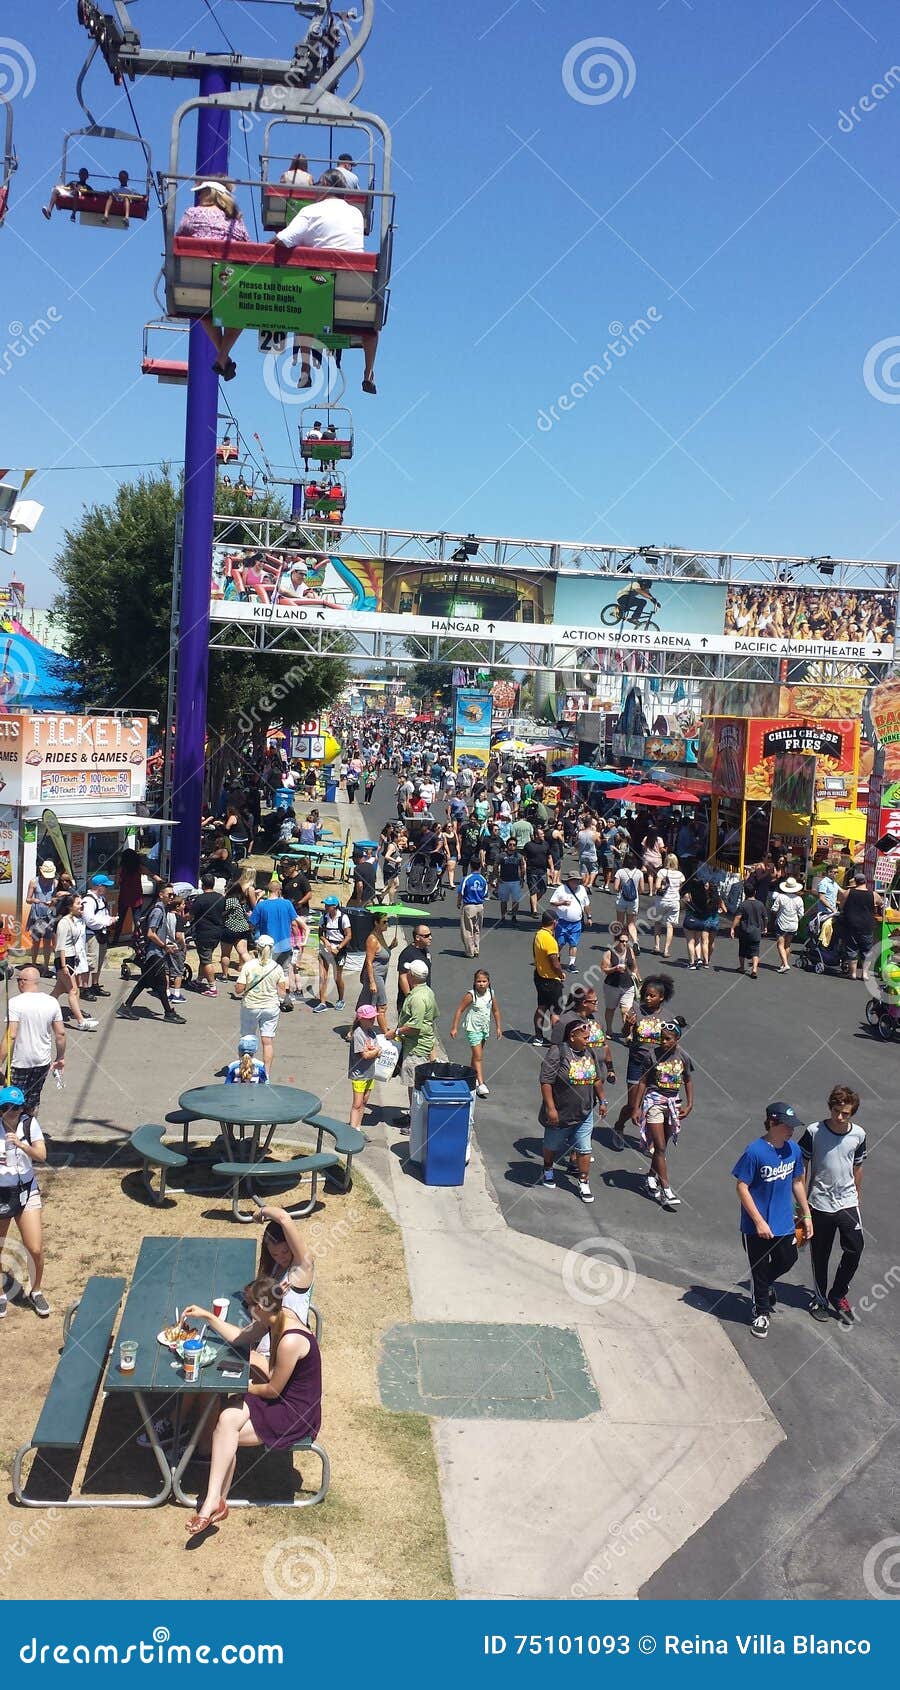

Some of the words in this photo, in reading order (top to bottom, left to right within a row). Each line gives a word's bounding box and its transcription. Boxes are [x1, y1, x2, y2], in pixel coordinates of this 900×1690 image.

[240, 281, 262, 290] Please
[263, 282, 275, 291] Exit
[277, 283, 302, 294] Quickly
[239, 291, 252, 299] And
[262, 293, 275, 301] The
[239, 301, 254, 310] Ride
[255, 303, 272, 312] Does
[274, 304, 286, 312] Not
[287, 305, 302, 314] Stop
[260, 330, 286, 351] 29
[443, 573, 458, 583] THE
[461, 574, 496, 585] HANGAR
[253, 607, 273, 618] KID
[276, 609, 308, 620] LAND
[431, 621, 480, 633] HANGAR
[562, 630, 605, 641] ACTION
[608, 632, 651, 644] SPORTS
[653, 636, 691, 647] ARENA
[735, 641, 777, 652] PACIFIC
[780, 644, 866, 657] AMPHITHEATRE
[28, 717, 143, 747] TICKETS
[768, 730, 797, 742] CHILI
[799, 729, 839, 744] CHEESE
[785, 739, 821, 751] FRIES
[45, 752, 78, 763] RIDES
[80, 753, 88, 762] &
[91, 752, 128, 762] GAMES
[51, 774, 60, 783] 10
[49, 786, 59, 794] 40
